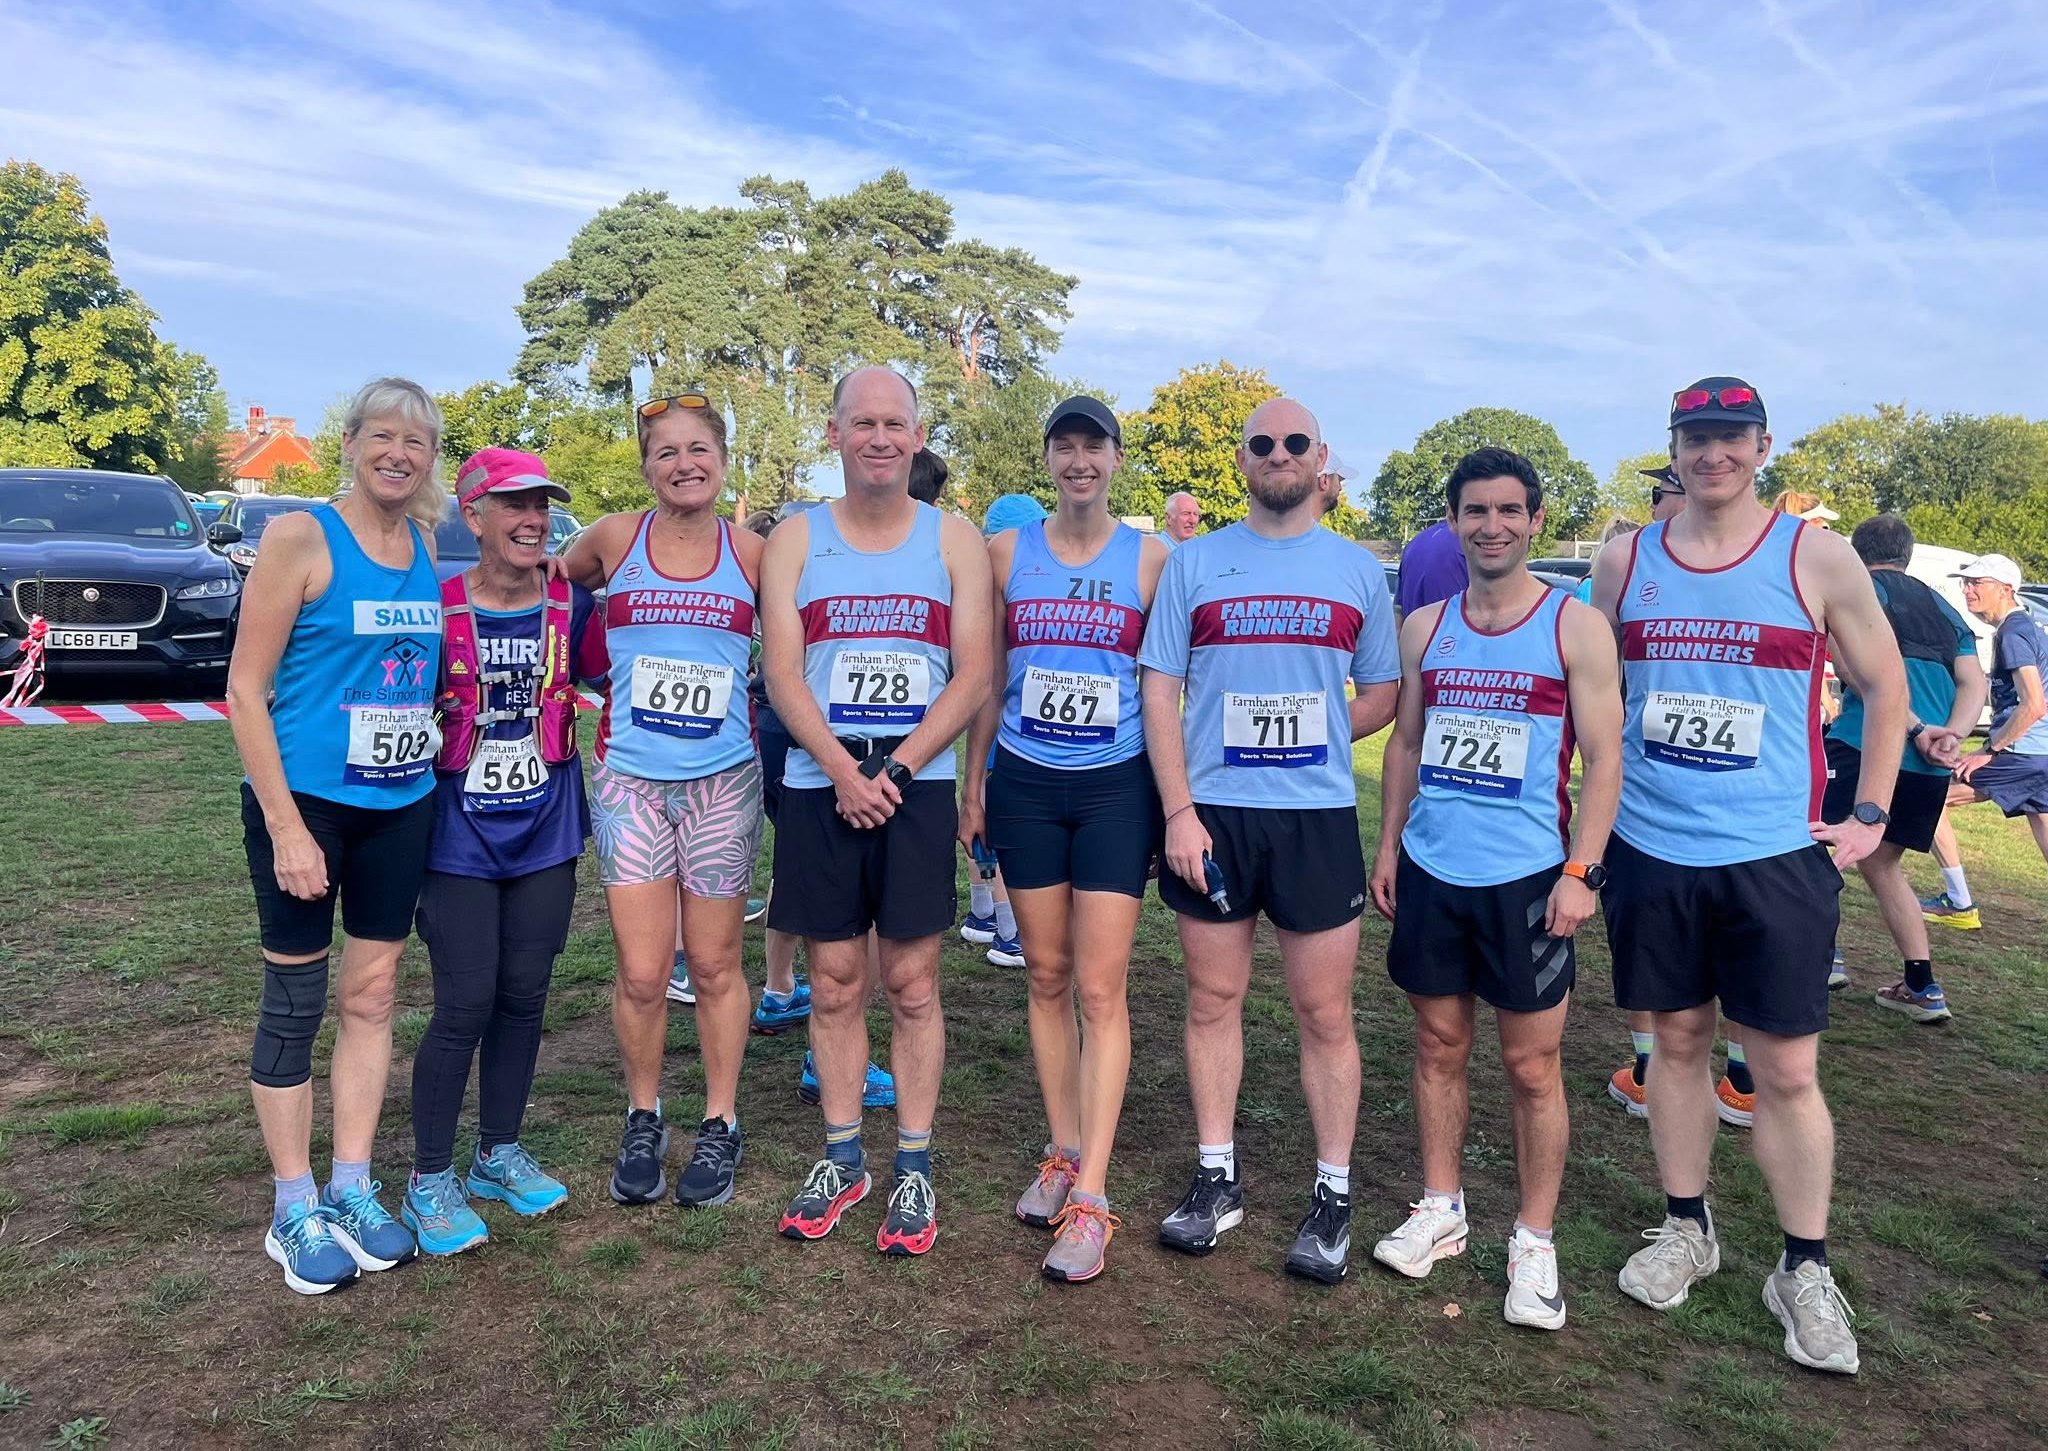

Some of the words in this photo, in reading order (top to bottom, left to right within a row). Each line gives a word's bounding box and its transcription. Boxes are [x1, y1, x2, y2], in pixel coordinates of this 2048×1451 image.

[1068, 577, 1113, 603] ZIE
[627, 591, 736, 612] FARNHAM
[826, 599, 929, 618] FARNHAM
[1221, 600, 1331, 621] FARNHAM
[375, 608, 438, 626] SALLY
[631, 608, 732, 628] RUNNERS
[828, 615, 926, 634] RUNNERS
[1015, 602, 1125, 628] FARNHAM
[1017, 622, 1121, 646] RUNNERS
[1224, 617, 1330, 637] RUNNERS
[1642, 621, 1760, 643] FARNHAM
[51, 633, 94, 647] LC68
[99, 634, 131, 647] FLF
[480, 639, 541, 664] SHIR
[841, 653, 882, 664] Farnham
[885, 653, 921, 667] Pilgrim
[1645, 642, 1755, 664] RUNNERS
[641, 658, 686, 673] Farnham
[690, 664, 725, 680] Pilgrim
[655, 671, 671, 680] Half
[673, 673, 709, 684] Marathon
[870, 665, 906, 673] Marathon
[848, 672, 909, 703] 728
[1031, 669, 1073, 684] Farnham
[1076, 675, 1111, 691] Pilgrim
[1044, 683, 1060, 692] Half
[1061, 685, 1097, 695] Marathon
[1434, 670, 1534, 692] FARNHAM
[343, 688, 372, 700] The
[377, 688, 416, 700] Simon
[505, 690, 531, 704] RES
[649, 680, 711, 715] 690
[1232, 695, 1279, 708] Farnham
[1282, 693, 1319, 710] Pilgrim
[1436, 689, 1529, 711] RUNNERS
[1039, 691, 1099, 724] 667
[1248, 708, 1264, 716] Half
[1266, 708, 1304, 716] Marathon
[1656, 694, 1706, 708] Farnham
[1710, 698, 1754, 715] Pilgrim
[1671, 706, 1690, 714] Half
[361, 710, 408, 722] Farnham
[663, 719, 683, 727] Timing
[1435, 714, 1476, 729] Farnham
[1480, 719, 1521, 736] Pilgrim
[1033, 725, 1050, 733] Sports
[1053, 728, 1072, 736] Timing
[1252, 715, 1298, 746] 711
[1445, 726, 1463, 736] Half
[1462, 729, 1502, 741] Marathon
[1664, 713, 1736, 752] 734
[371, 730, 429, 765] 503
[1440, 734, 1502, 773] 724
[1660, 748, 1679, 758] Sports
[1681, 753, 1704, 763] Timing
[1706, 757, 1738, 766] Solutions
[483, 756, 539, 791] 560
[1432, 772, 1449, 780] Sports
[1451, 775, 1473, 784] Timing
[1475, 779, 1505, 788] Solutions
[525, 790, 545, 800] Solution
